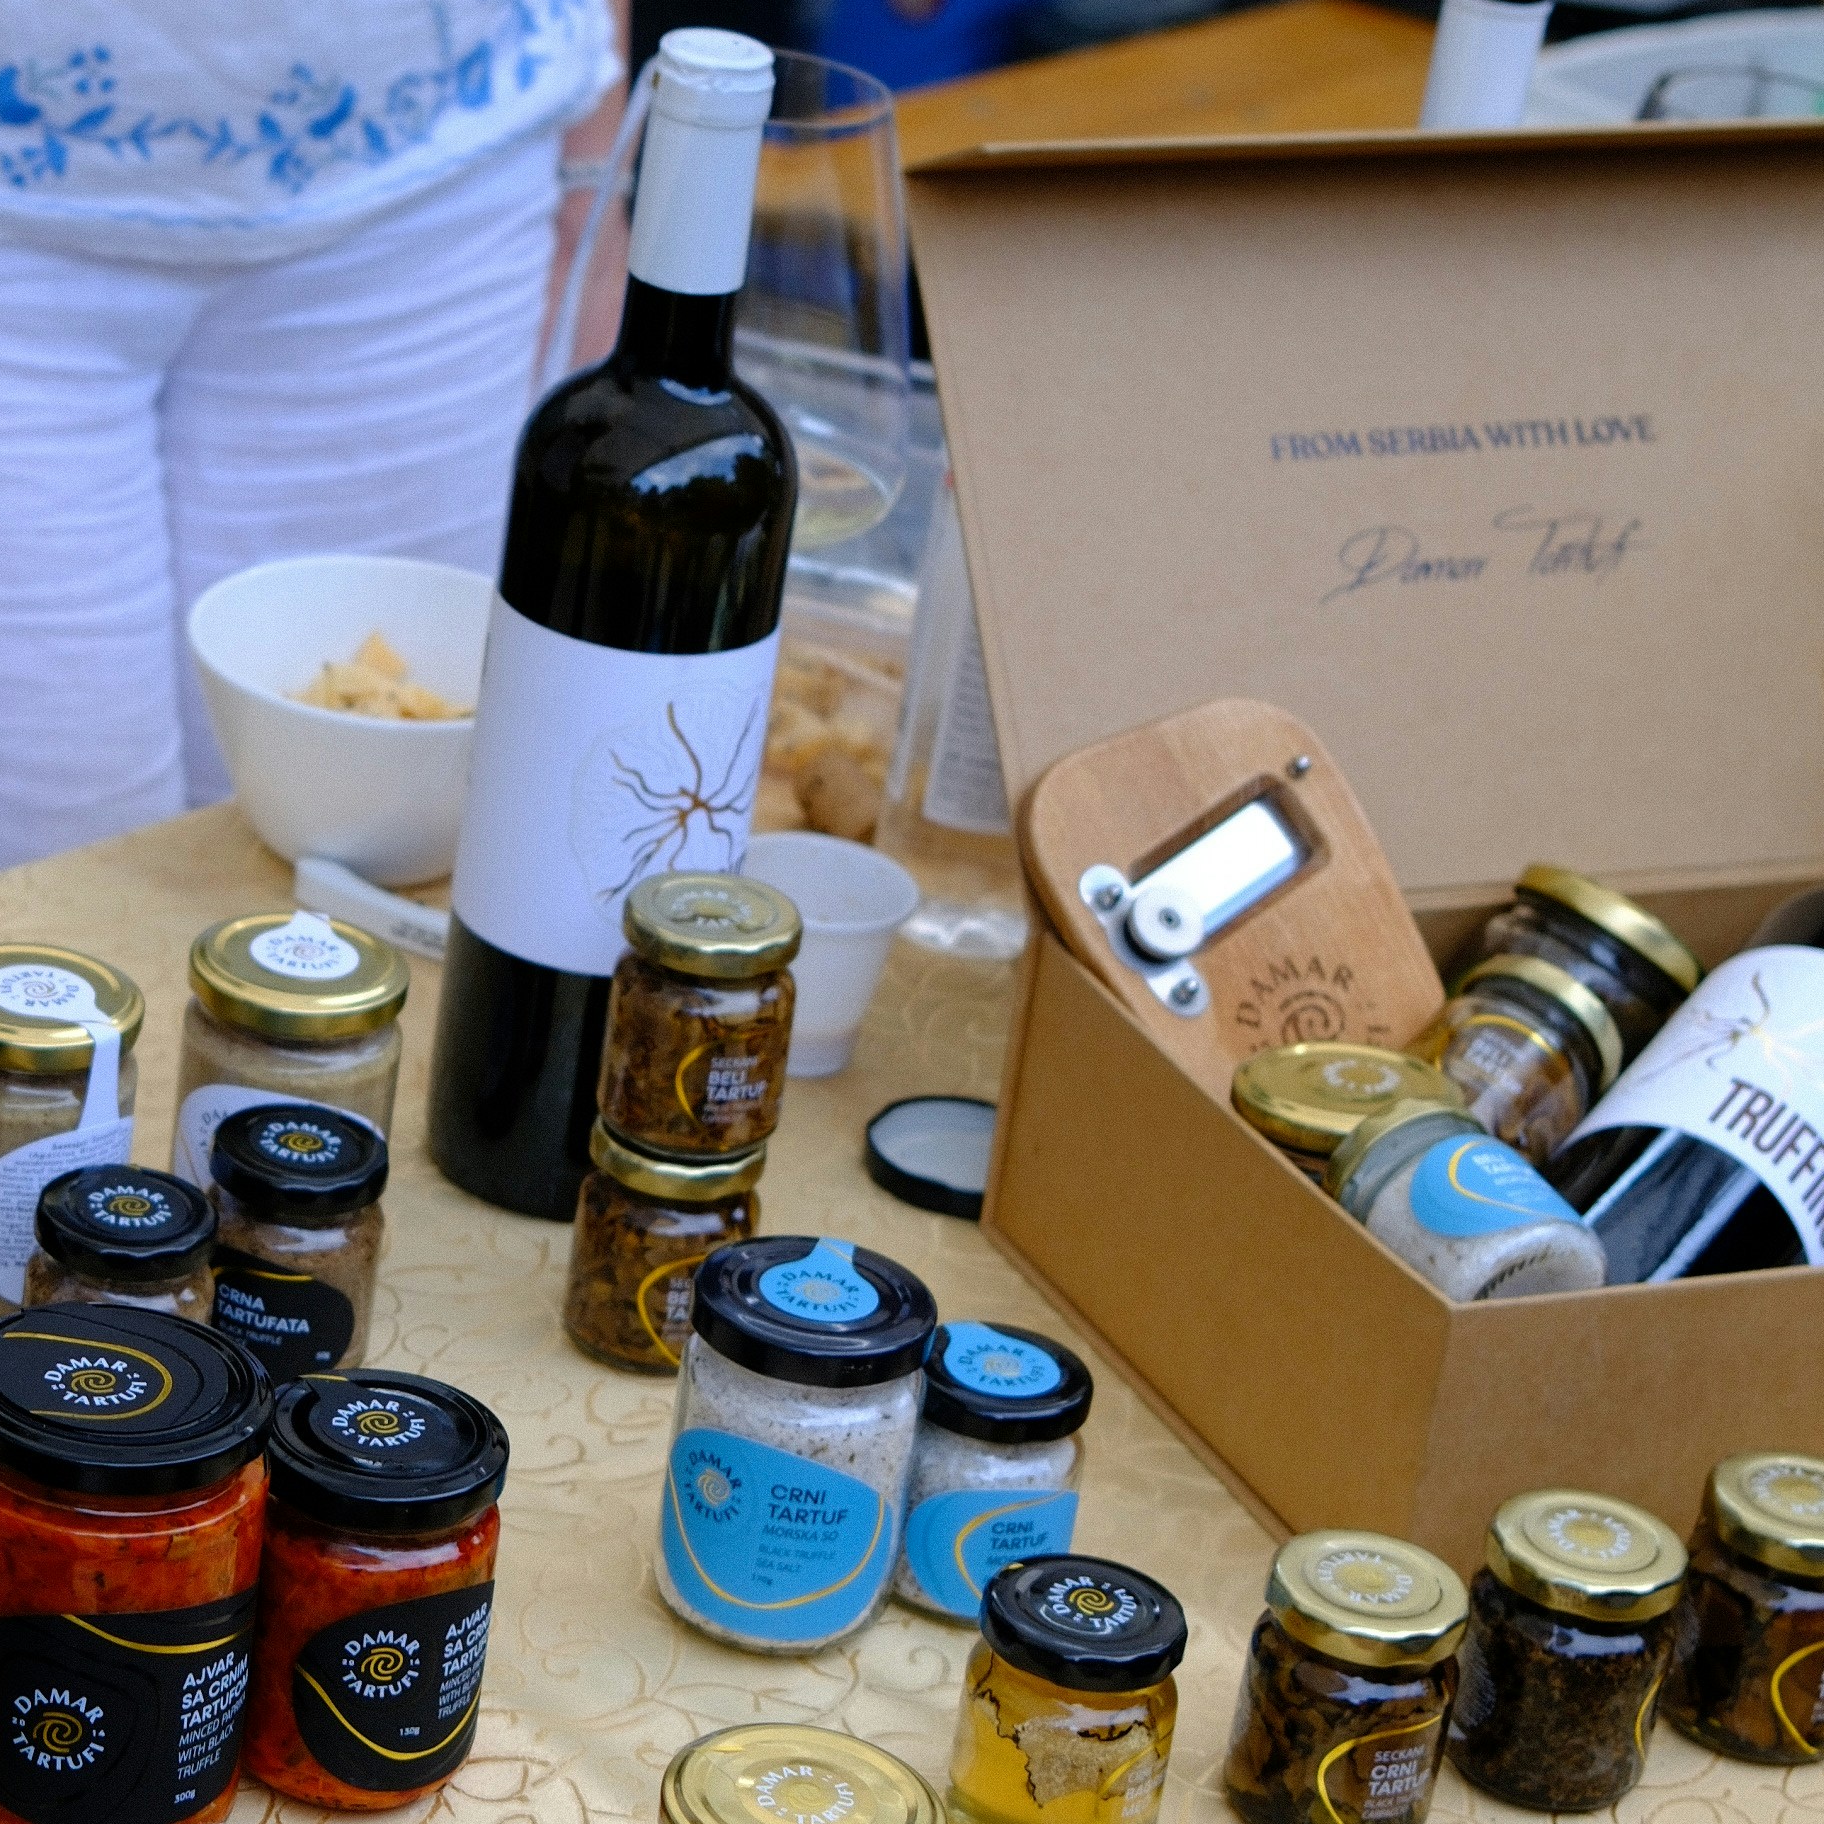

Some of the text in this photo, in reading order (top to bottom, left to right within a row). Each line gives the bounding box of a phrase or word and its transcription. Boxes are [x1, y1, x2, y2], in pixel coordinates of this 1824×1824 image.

[1269, 412, 1656, 463] FROM SERBIA WITH LOVE
[88, 1185, 165, 1203] DAMAR
[218, 1282, 266, 1312] CRNA
[218, 1298, 311, 1335] TARTUFATA
[43, 1356, 128, 1382] DAMAR
[62, 1381, 148, 1407] TARTUFI
[331, 1398, 401, 1428] DAMAR
[357, 1417, 427, 1447] TARTUFI
[687, 1448, 743, 1490] DAMAR
[769, 1483, 828, 1506] CRNI
[768, 1502, 849, 1526] TARTUF
[1047, 1575, 1096, 1616] DAMAR
[1088, 1586, 1138, 1630] TARTUFI
[445, 1602, 488, 1641] AJVAR
[344, 1629, 421, 1657] DAMAR
[443, 1638, 464, 1658] SA
[181, 1652, 248, 1710] SA CRNIM
[182, 1650, 235, 1691] AJVAR
[342, 1669, 420, 1699] TARTUFI
[13, 1686, 105, 1725] DAMAR
[11, 1715, 26, 1728] 20
[178, 1717, 220, 1748] MINCED
[12, 1729, 106, 1771] TARTUFI
[178, 1720, 235, 1765] WITH BLACK
[177, 1747, 222, 1781] TRUFFLE
[1370, 1758, 1417, 1780] CRNI
[756, 1764, 814, 1809] DAMAR
